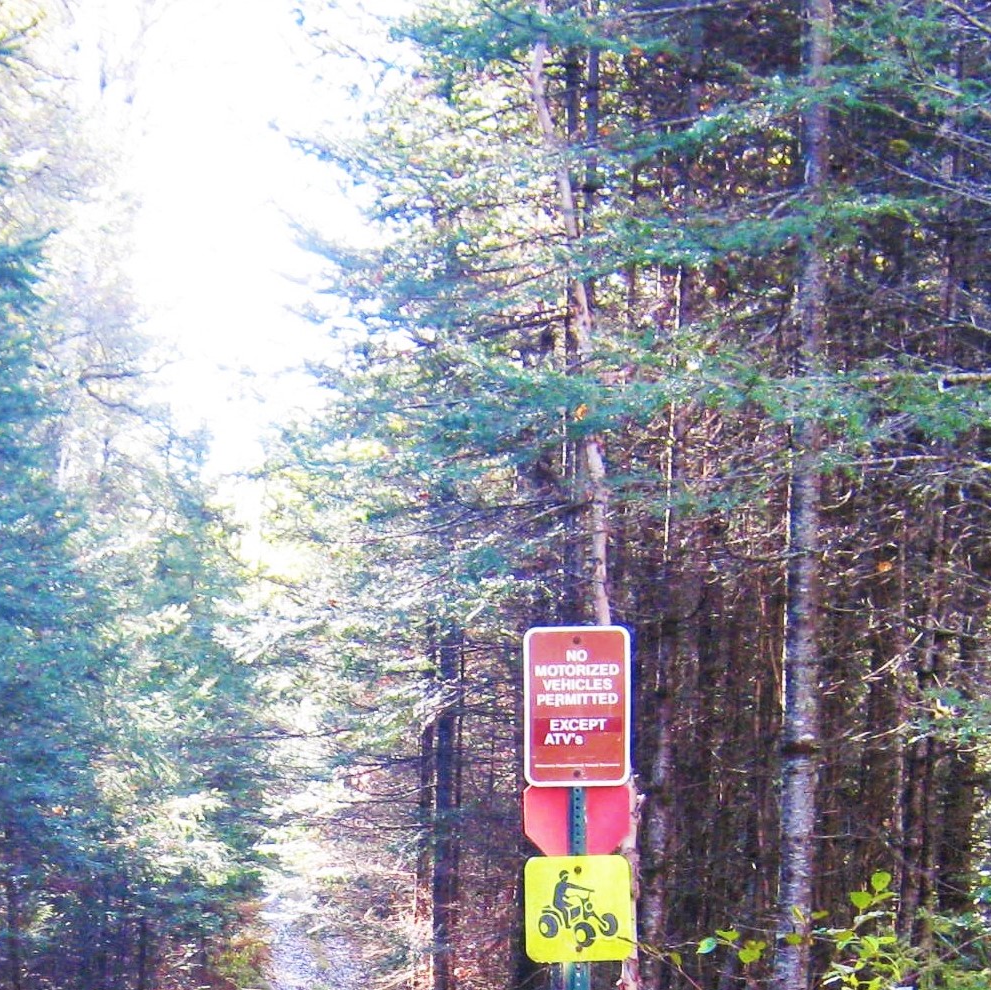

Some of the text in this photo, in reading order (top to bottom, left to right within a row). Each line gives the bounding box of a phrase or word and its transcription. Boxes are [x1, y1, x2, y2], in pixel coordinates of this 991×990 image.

[566, 650, 587, 662] NO
[535, 664, 619, 676] MOTORIZED
[543, 679, 612, 691] VEHICLES
[537, 693, 618, 706] PERMITTED
[550, 719, 607, 731] EXCEPT
[544, 734, 583, 745] ATV's
